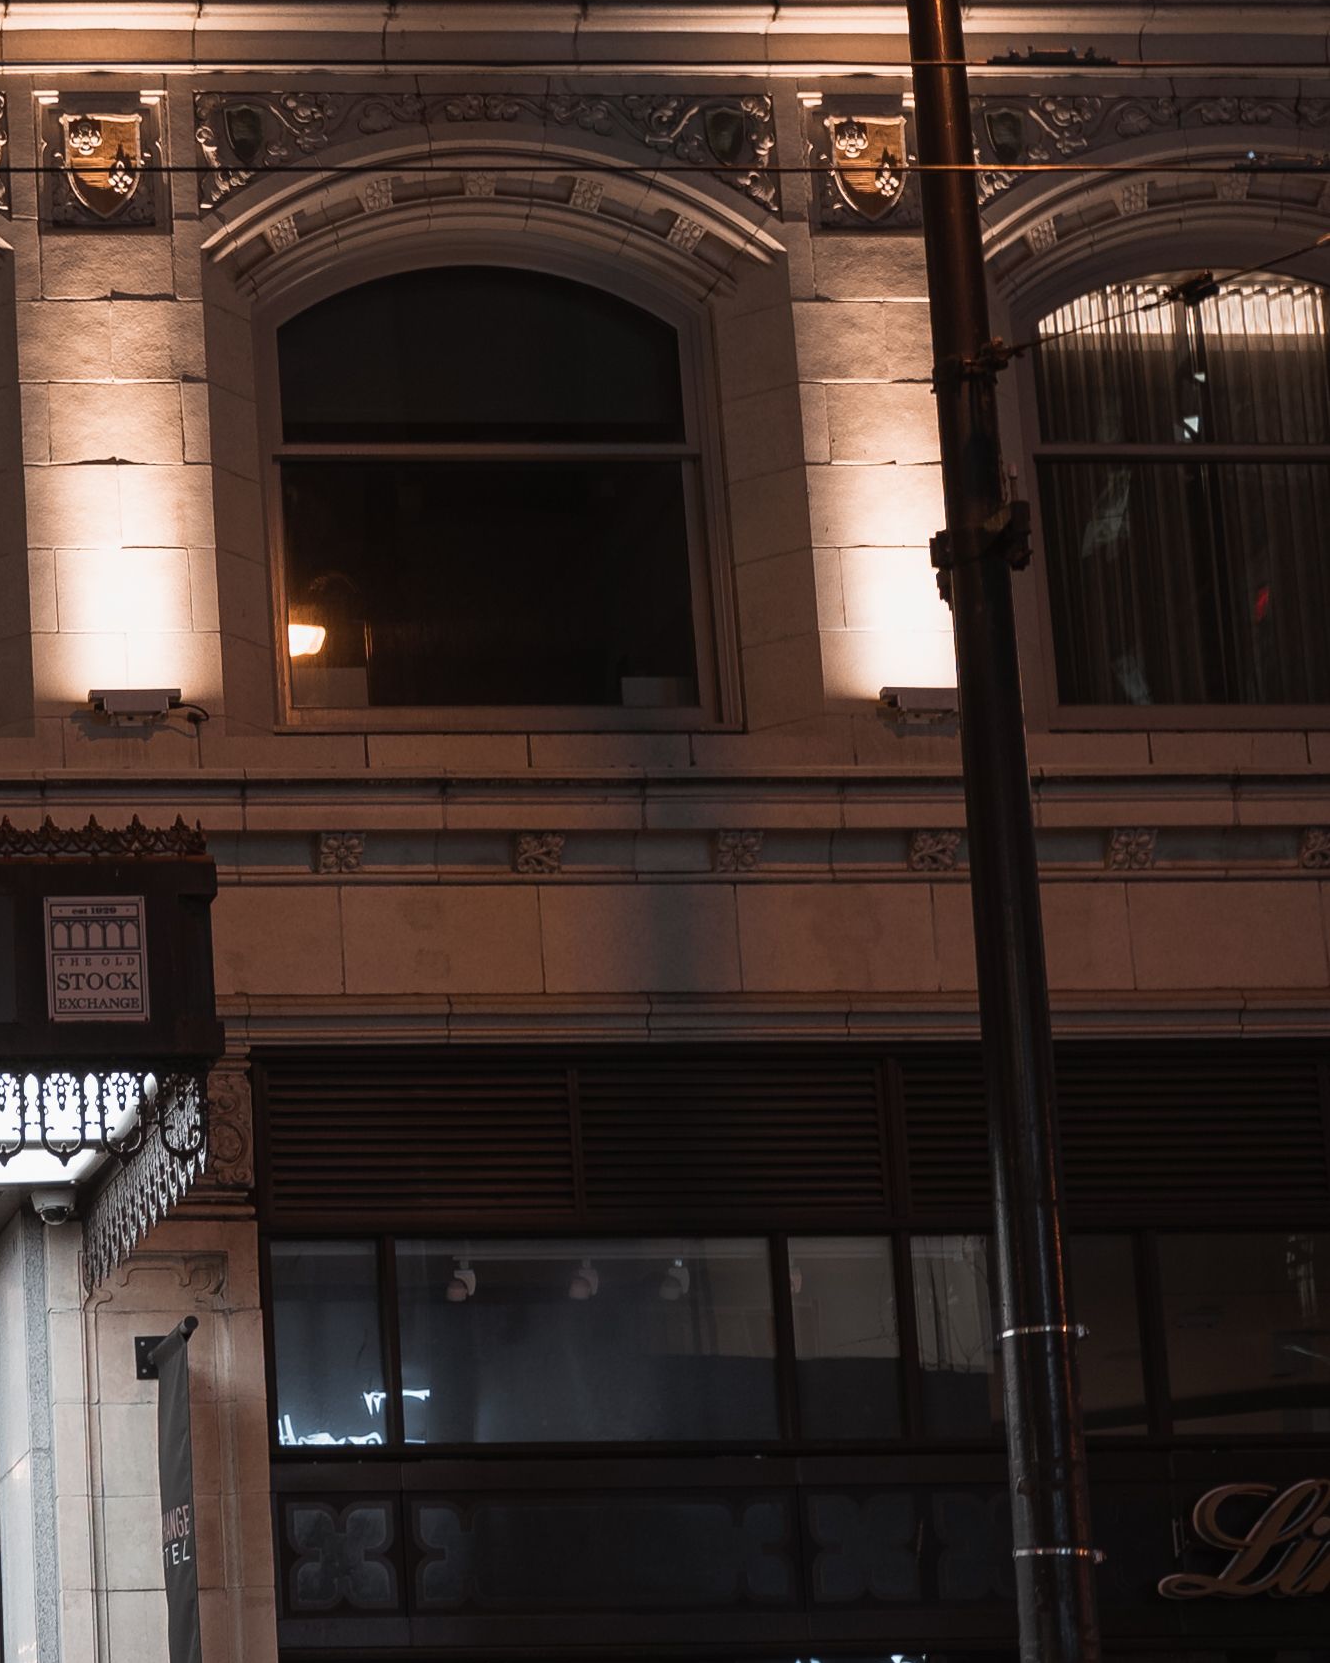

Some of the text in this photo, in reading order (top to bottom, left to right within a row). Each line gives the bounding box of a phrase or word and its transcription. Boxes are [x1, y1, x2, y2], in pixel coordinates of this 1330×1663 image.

[57, 957, 135, 966] THE OLD
[57, 972, 139, 991] STOCK
[59, 997, 140, 1009] EXCHANGE
[165, 1540, 191, 1569] TEL
